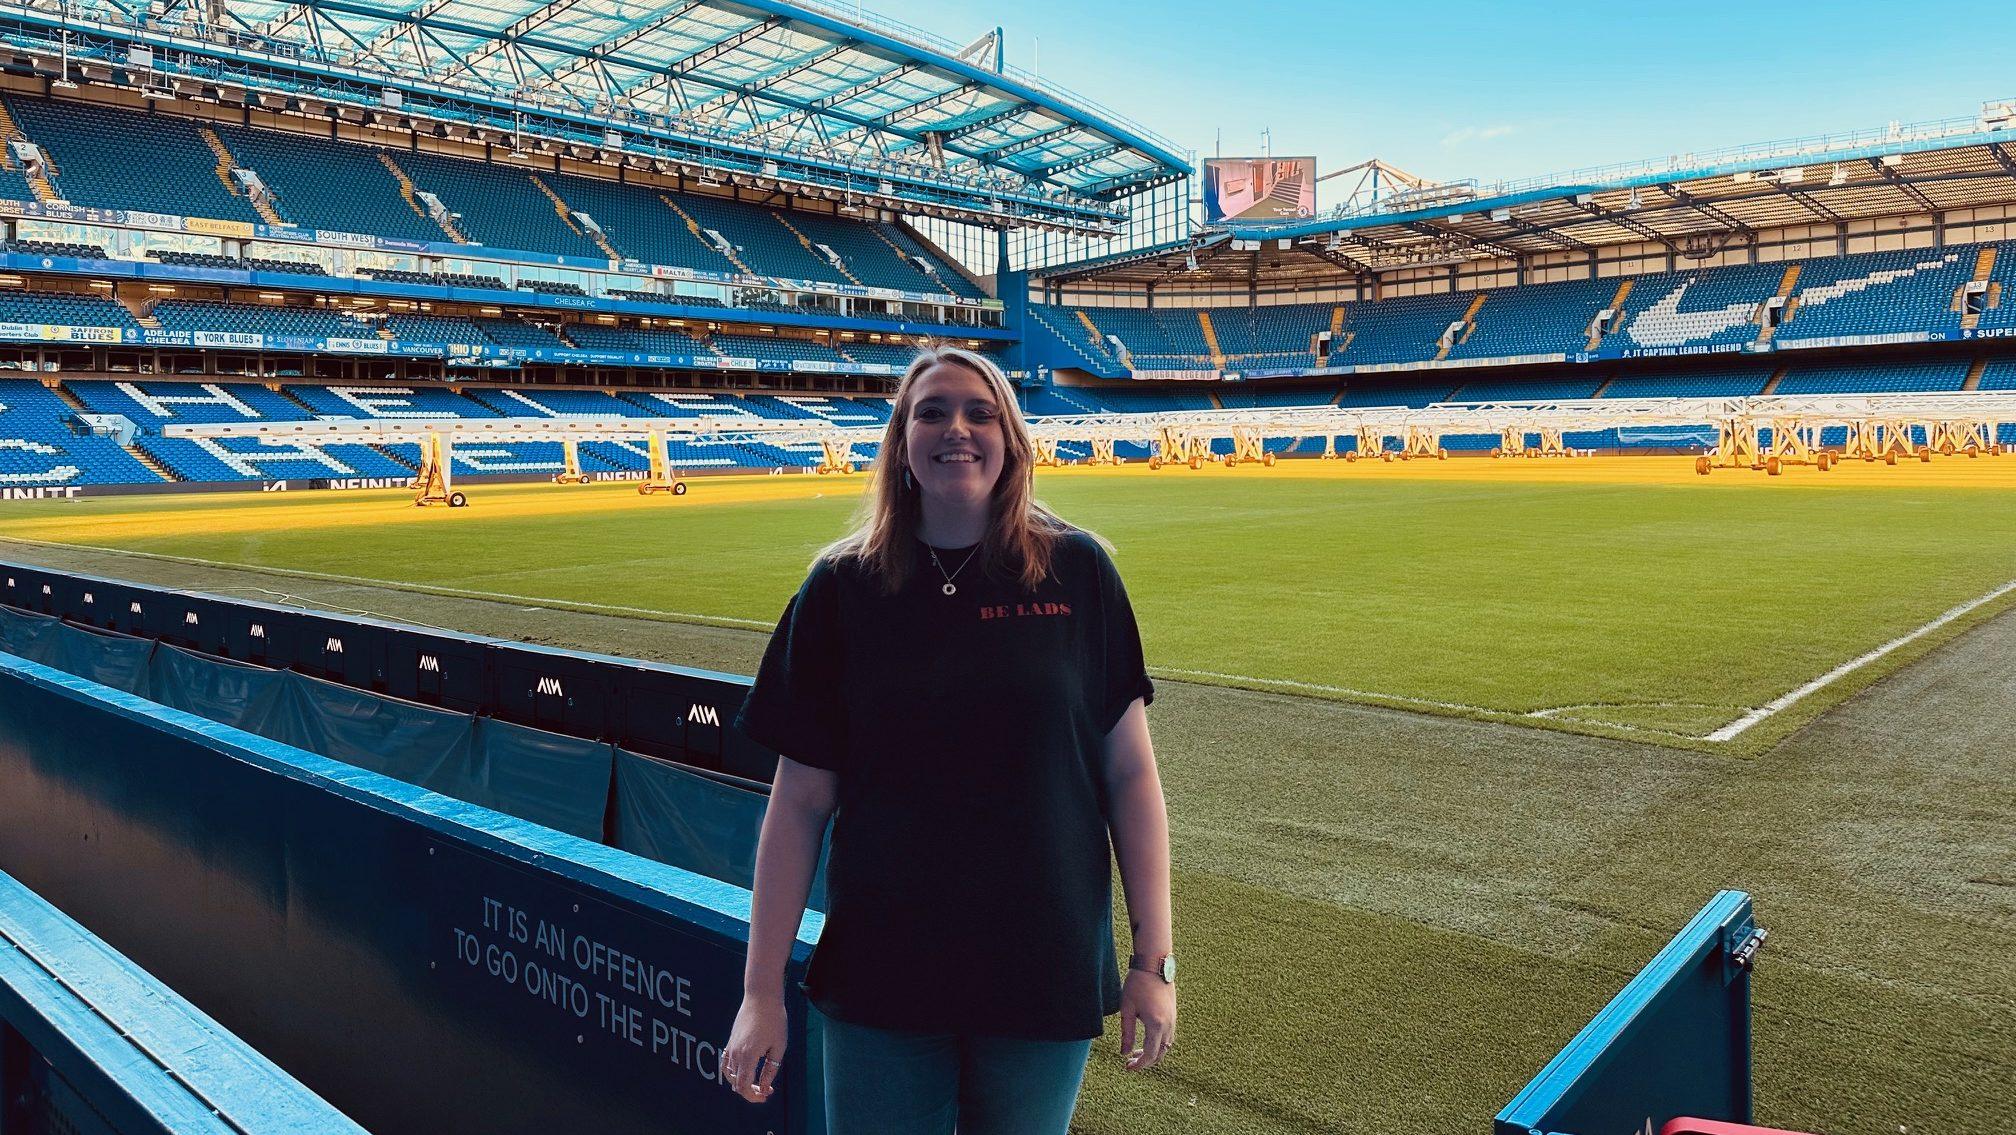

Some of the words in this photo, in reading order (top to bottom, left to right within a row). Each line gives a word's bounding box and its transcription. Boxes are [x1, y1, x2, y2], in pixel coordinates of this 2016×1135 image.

[46, 203, 86, 213] CORNISH
[46, 210, 73, 219] BLUES
[190, 220, 208, 229] EAST
[210, 223, 240, 232] BELFAST
[317, 230, 348, 242] SOUTH
[351, 233, 375, 244] WEST
[663, 269, 686, 277] MALTA
[554, 297, 585, 306] CHELSEA
[143, 329, 192, 338] ADELAIDE
[1930, 332, 1946, 340] ON
[1977, 327, 2016, 338] SUPE
[145, 337, 190, 345] CHELSEA
[204, 333, 225, 342] YORK
[229, 334, 253, 344] BLUES
[1792, 336, 1836, 348] CHELSEA
[1840, 335, 1859, 346] OUR
[1865, 332, 1913, 345] RELIGION
[402, 346, 443, 354] VANCOUVER
[1633, 349, 1641, 357] JT
[1643, 347, 1678, 357] CAPTAIN,
[1680, 345, 1710, 355] LEADER,
[1712, 343, 1741, 353] LEGEND
[1180, 371, 1212, 379] LEGEND
[96, 415, 102, 423] 2
[981, 606, 1009, 619] BE
[1017, 602, 1072, 616] LADS
[537, 677, 562, 696] AIM
[688, 704, 719, 726] AIM
[482, 896, 502, 931] IT
[508, 906, 528, 944] IS
[535, 919, 566, 961] AN
[573, 935, 692, 1017] OFFENCE
[454, 927, 480, 966] TO
[486, 944, 517, 984] GO
[524, 961, 589, 1018] ONTO
[595, 992, 643, 1047] THE
